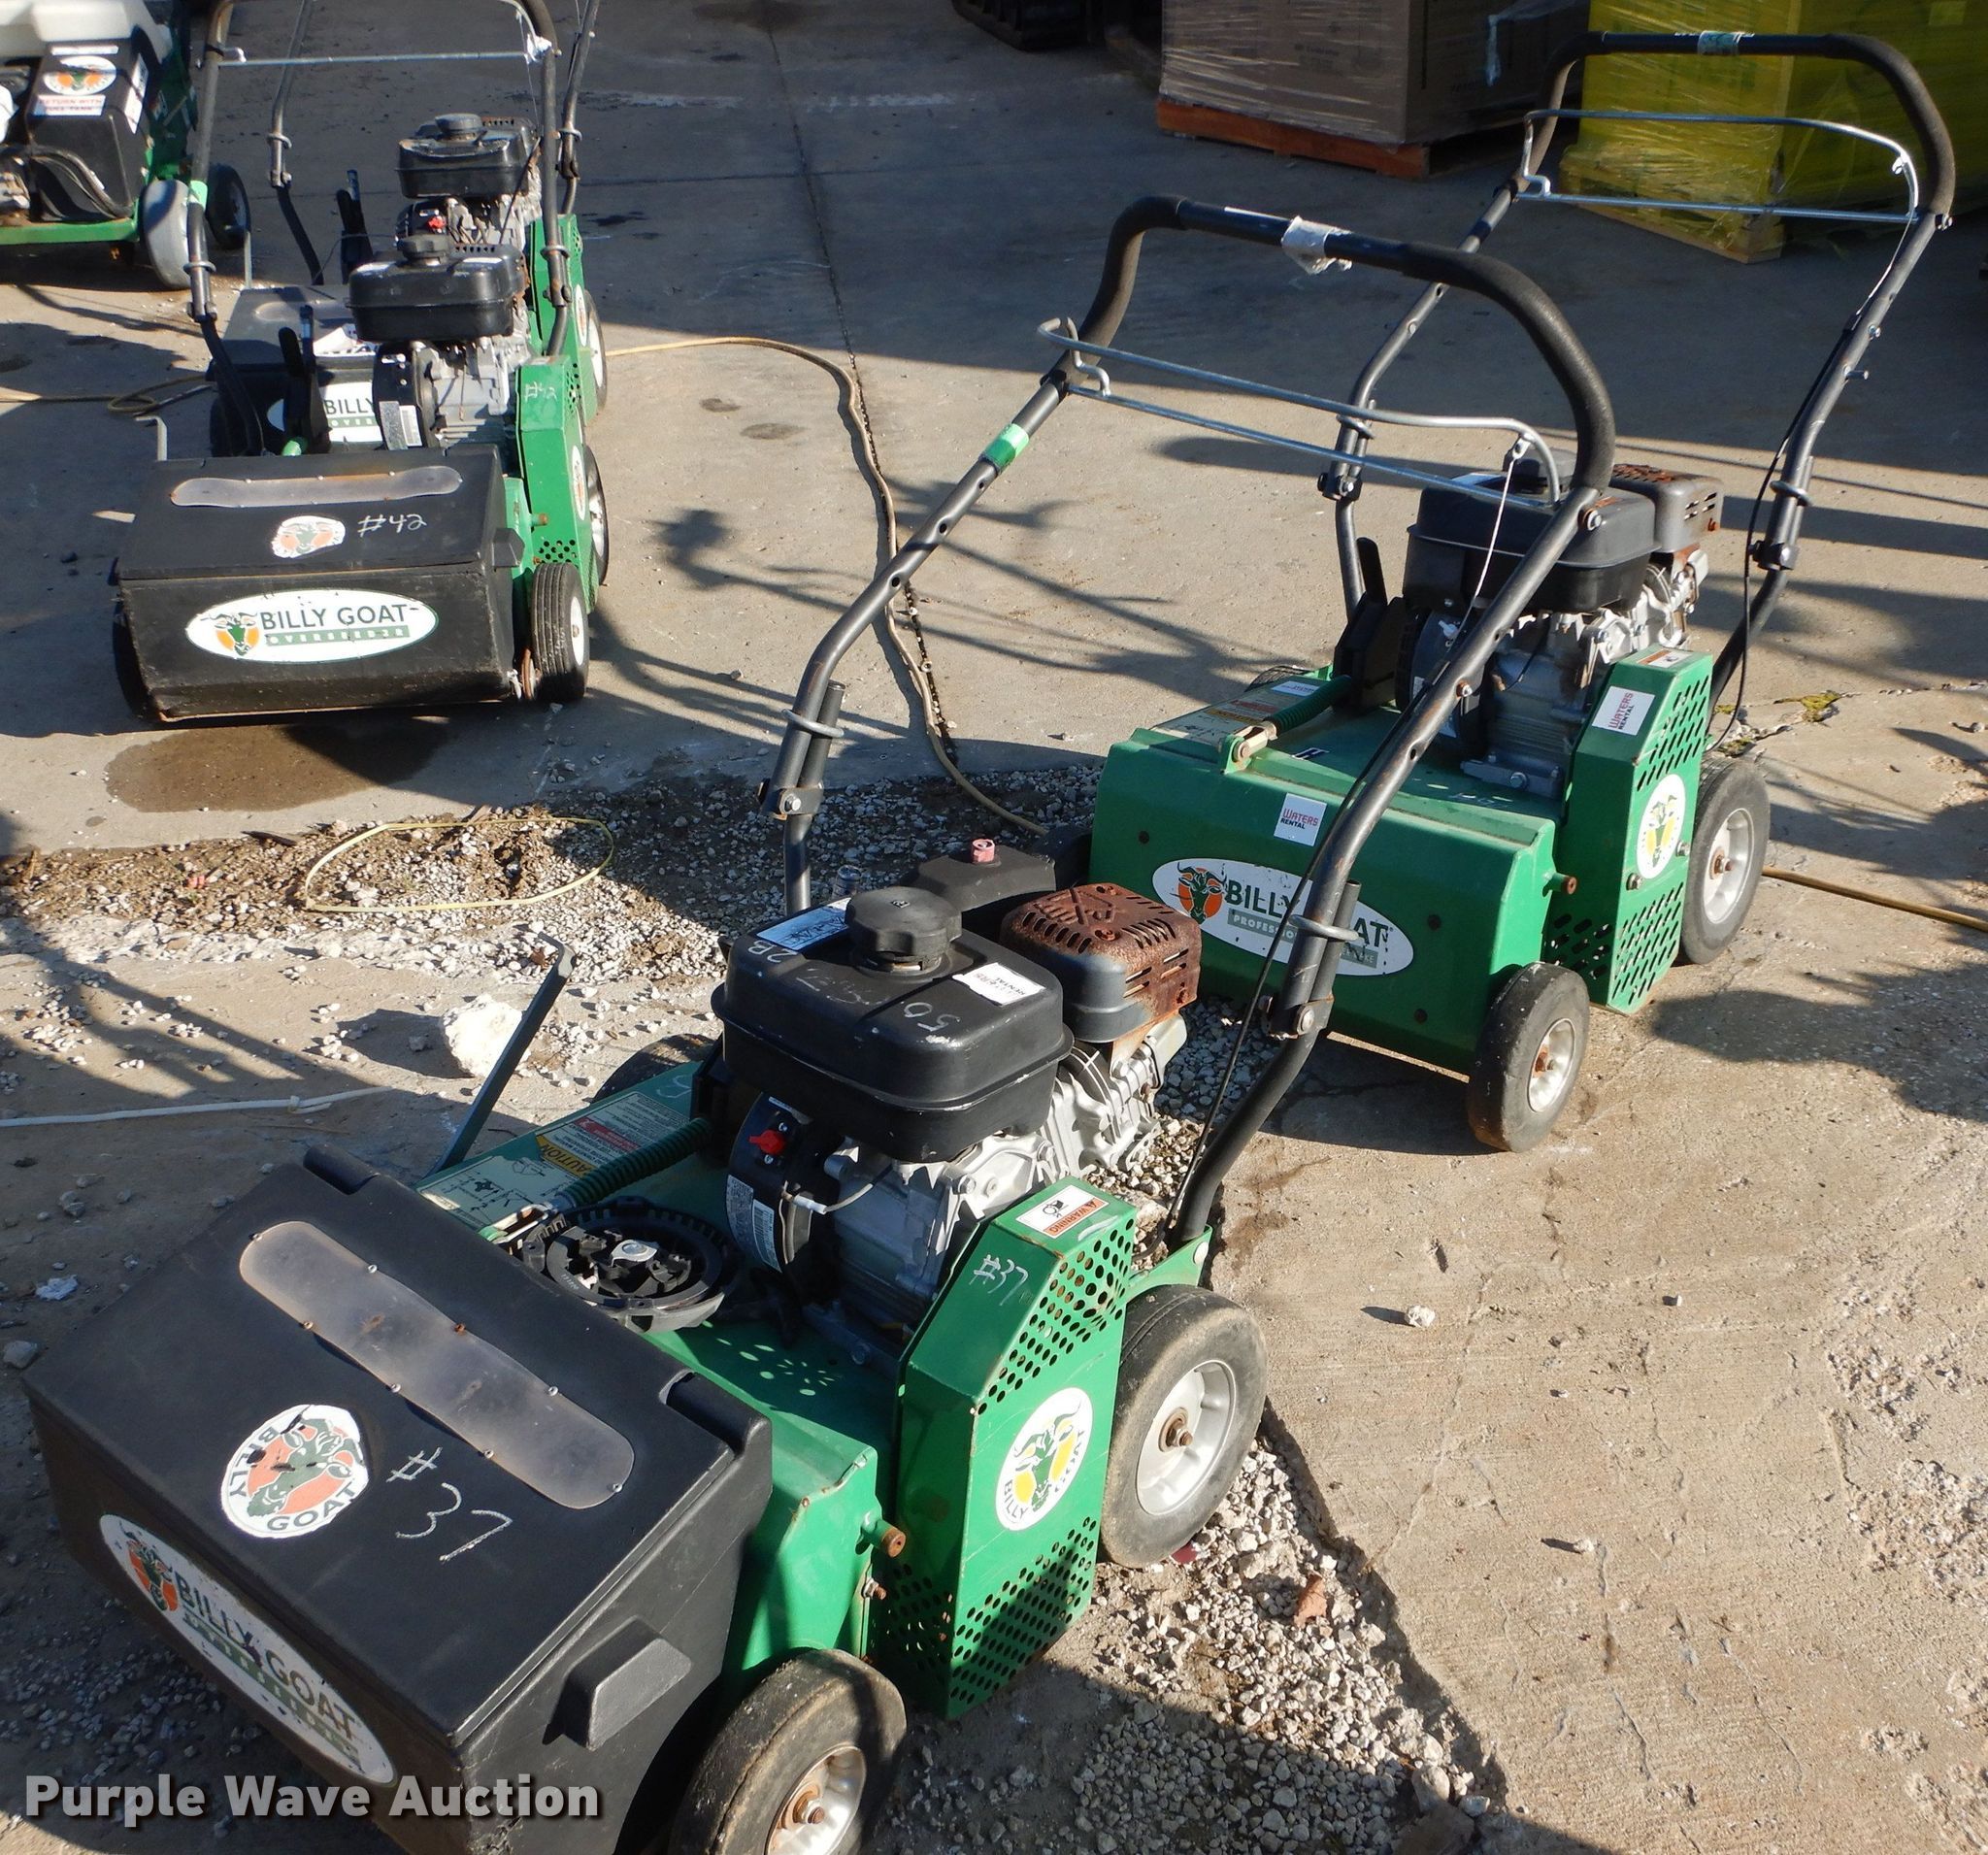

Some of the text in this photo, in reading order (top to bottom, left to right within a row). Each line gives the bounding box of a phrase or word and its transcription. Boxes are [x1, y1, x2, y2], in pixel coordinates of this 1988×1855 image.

[357, 513, 427, 537] #42
[260, 604, 408, 630] BILLY GOAT
[1607, 692, 1634, 729] WATERS
[1617, 705, 1635, 730] RENTAL
[1280, 817, 1306, 830] RENTAL
[1281, 808, 1318, 826] WATERS
[541, 1143, 592, 1173] AUTION
[1048, 1207, 1088, 1233] WARNING
[969, 1254, 1028, 1307] #37
[266, 1486, 354, 1532] GOAT
[1004, 1479, 1029, 1519] BILLY
[265, 1649, 355, 1740] GOAT
